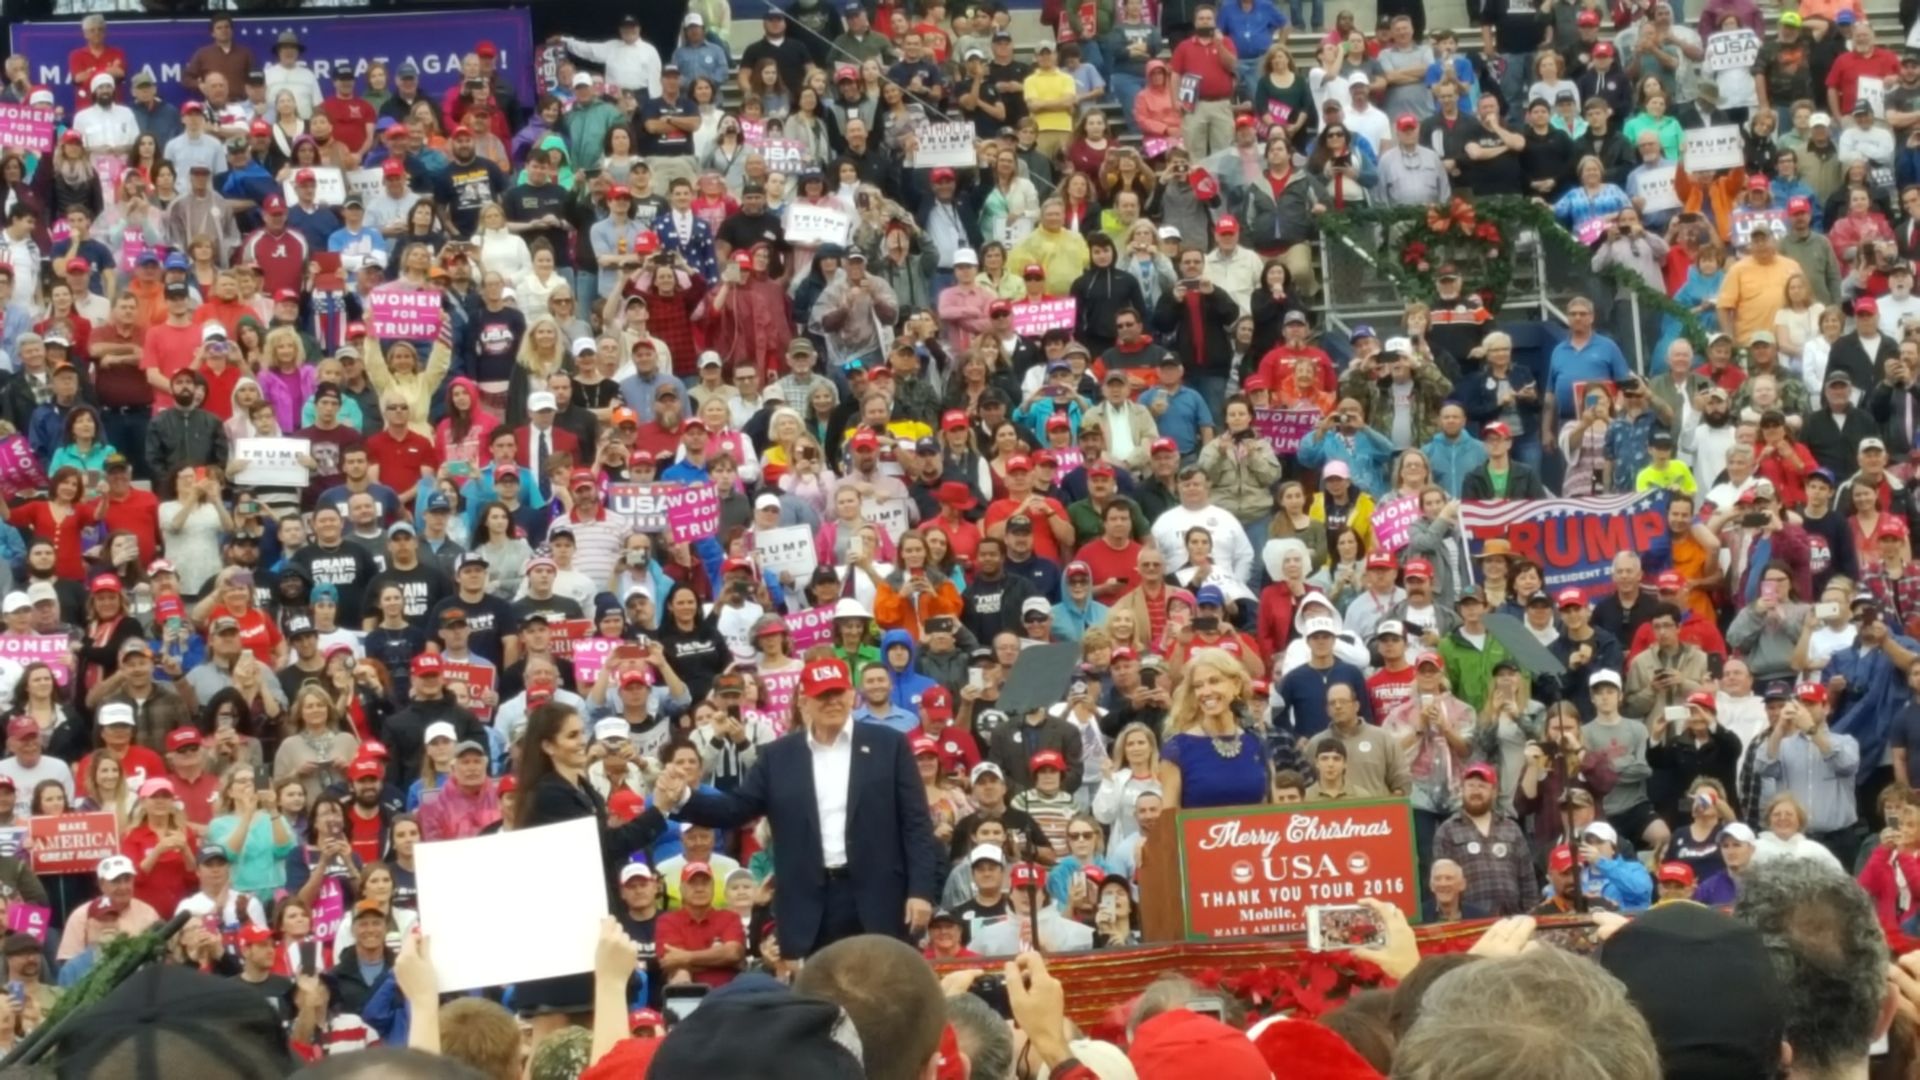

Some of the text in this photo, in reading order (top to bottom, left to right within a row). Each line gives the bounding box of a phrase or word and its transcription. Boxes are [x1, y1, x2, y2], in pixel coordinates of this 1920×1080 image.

[1713, 40, 1758, 56] USA
[405, 50, 507, 75] AGA!
[543, 46, 559, 92] USA
[10, 122, 33, 132] FOR
[919, 135, 971, 145] TRUMP
[1688, 137, 1738, 149] TRUMP
[754, 147, 801, 161] USA
[793, 214, 845, 227] TRUMP
[370, 293, 441, 307] WOMEN
[1012, 297, 1076, 316] WOMEN
[392, 309, 418, 320] FOR
[1031, 312, 1055, 323] FOR
[373, 322, 437, 336] TRUMP
[1014, 318, 1072, 335] TRUMP
[1255, 410, 1320, 425] WOMEN
[1271, 425, 1296, 434] FOR
[242, 449, 302, 460] TRUMP
[667, 484, 718, 508] WOM
[614, 494, 669, 514] USA
[1371, 497, 1419, 527] WOM
[675, 516, 718, 539] TRU
[758, 540, 808, 556] RUMP
[311, 556, 356, 570] DRAIN
[312, 573, 356, 586] SWAMP
[1545, 569, 1602, 585] RESIDENT
[399, 582, 427, 597] AIN
[403, 604, 428, 615] AMP
[786, 610, 834, 632] WOM
[813, 629, 831, 640] FO
[419, 656, 439, 667] USA
[443, 670, 470, 681] MAKE
[811, 665, 843, 682] USA
[58, 821, 88, 832] MAKE
[32, 832, 117, 852] AMERICA
[1198, 813, 1392, 857] Merry Christmas
[39, 848, 113, 864] GREAT AGAIN
[1261, 853, 1340, 882] USA
[1201, 877, 1404, 908] THANK YOU TOUR 2016
[1213, 923, 1307, 937] MAKE AMERICA
